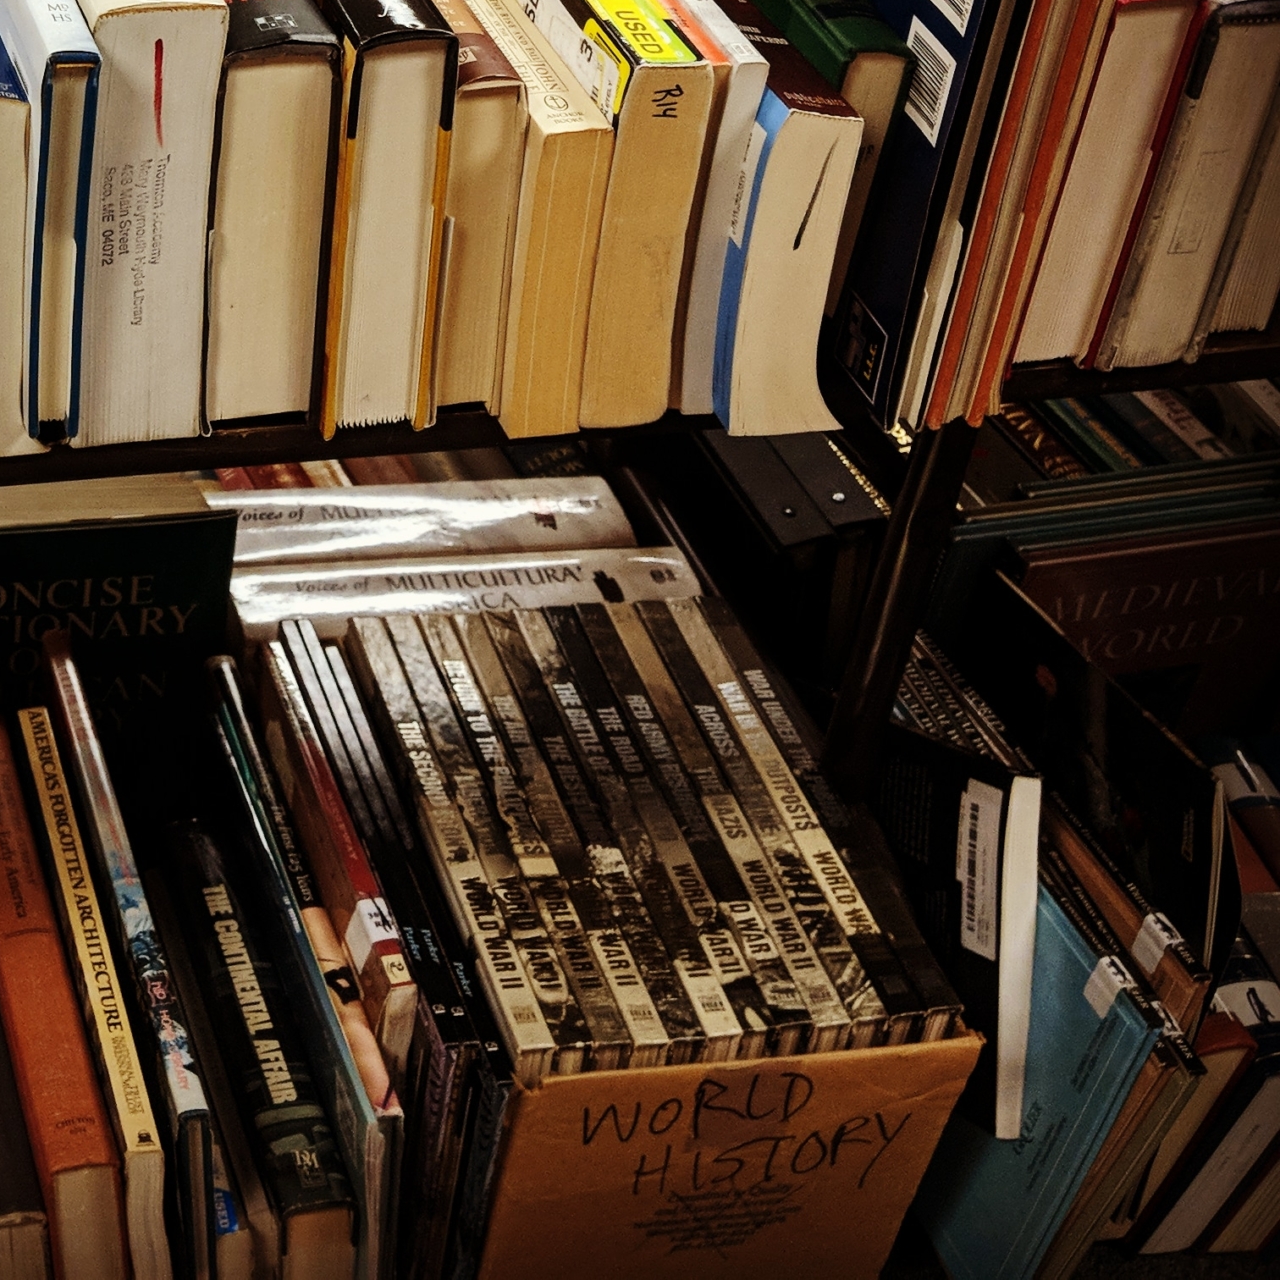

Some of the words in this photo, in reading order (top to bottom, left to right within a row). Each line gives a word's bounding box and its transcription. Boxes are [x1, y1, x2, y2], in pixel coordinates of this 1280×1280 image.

[616, 10, 663, 56] USED
[652, 84, 684, 119] R14
[713, 794, 747, 841] NAZIS
[45, 790, 90, 898] FORGOTTEN
[72, 895, 123, 1035] ARCHITECTURE
[201, 882, 225, 919] THE
[460, 877, 500, 934] WORLD
[484, 935, 516, 973] WAR
[501, 974, 525, 991] II
[211, 918, 263, 1035] CONTINENTAL
[456, 961, 473, 997] Parker
[254, 1035, 300, 1105] AFFAIR
[581, 1069, 816, 1147] WORLD
[632, 1110, 914, 1197] HISTORY
